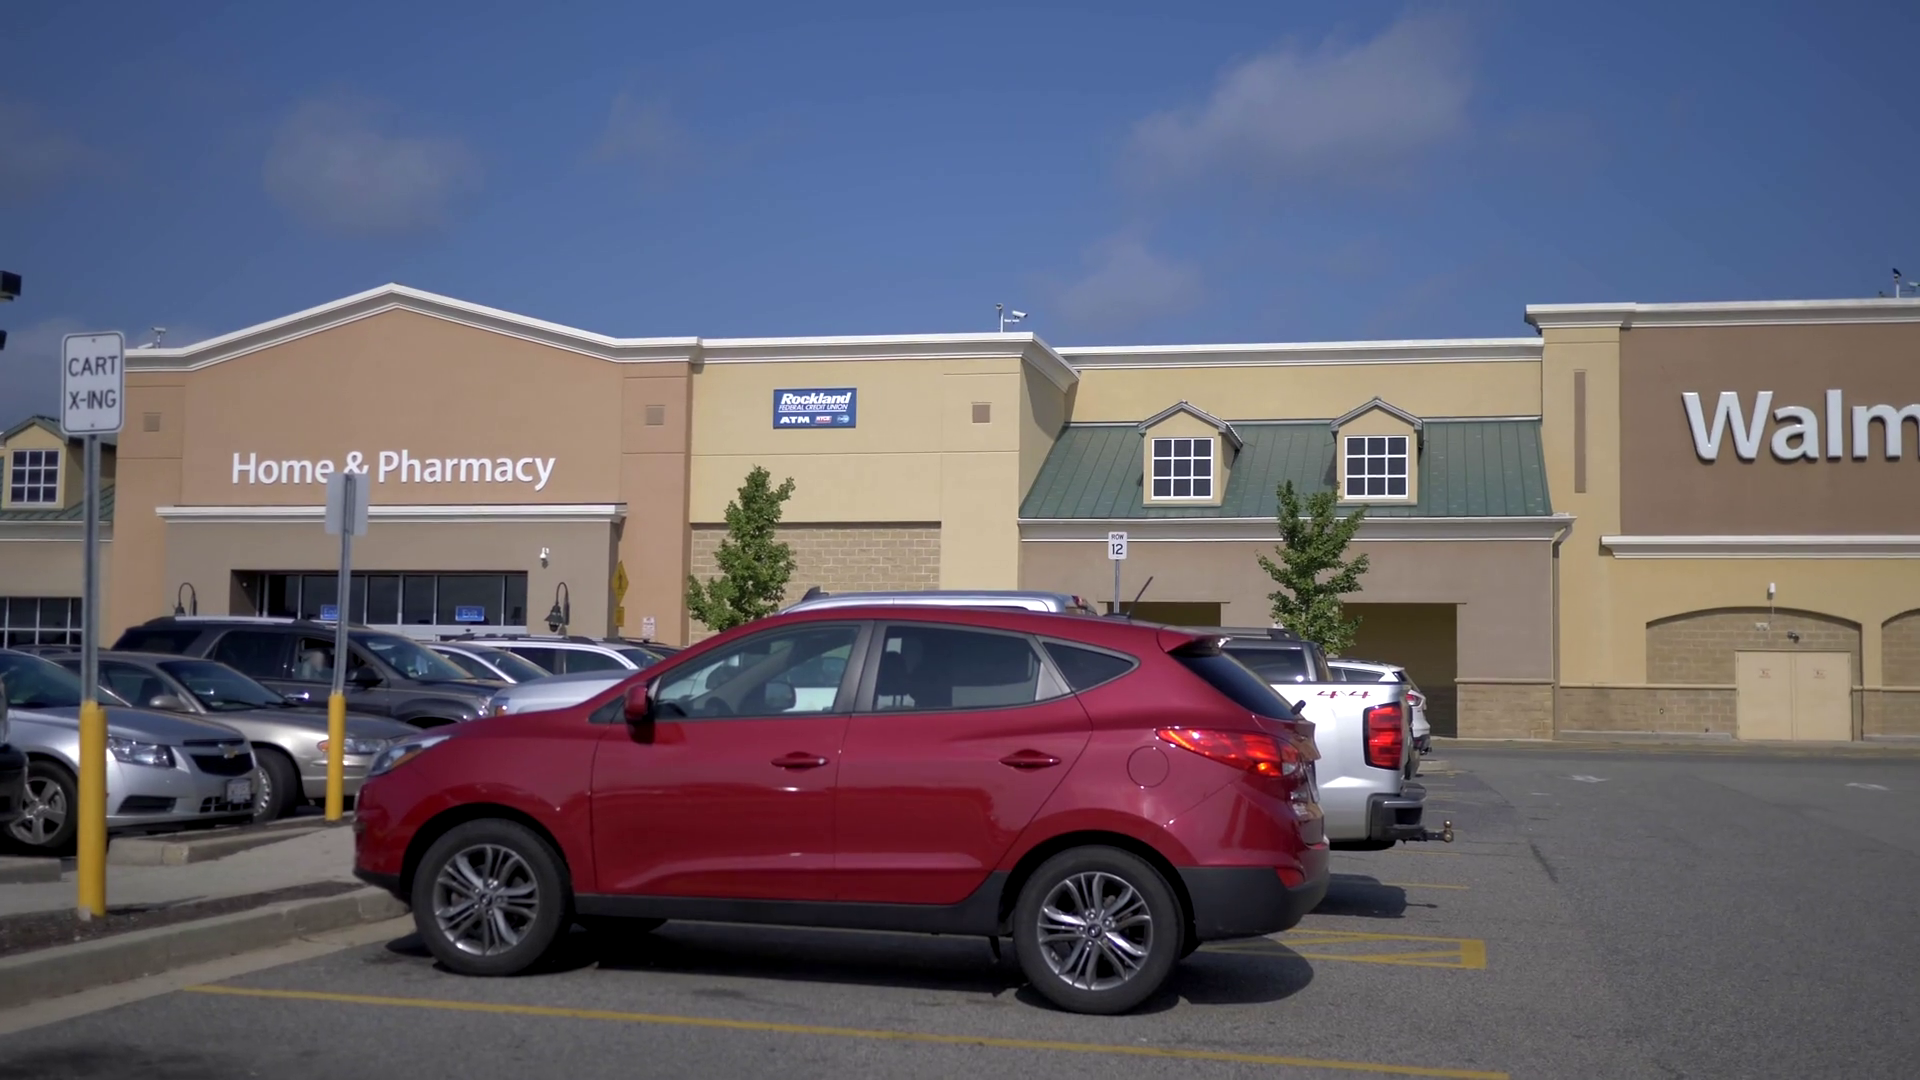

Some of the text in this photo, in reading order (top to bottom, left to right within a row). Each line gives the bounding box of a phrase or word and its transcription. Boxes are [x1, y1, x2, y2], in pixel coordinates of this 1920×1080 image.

[68, 355, 118, 377] CART
[68, 389, 117, 410] X-ING
[780, 392, 852, 405] Rockland
[779, 416, 811, 424] ATM
[1681, 388, 1920, 461] Walm
[232, 452, 335, 485] Home
[378, 449, 557, 492] Pharmacy
[1111, 533, 1125, 541] ROW
[1111, 543, 1124, 555] 12
